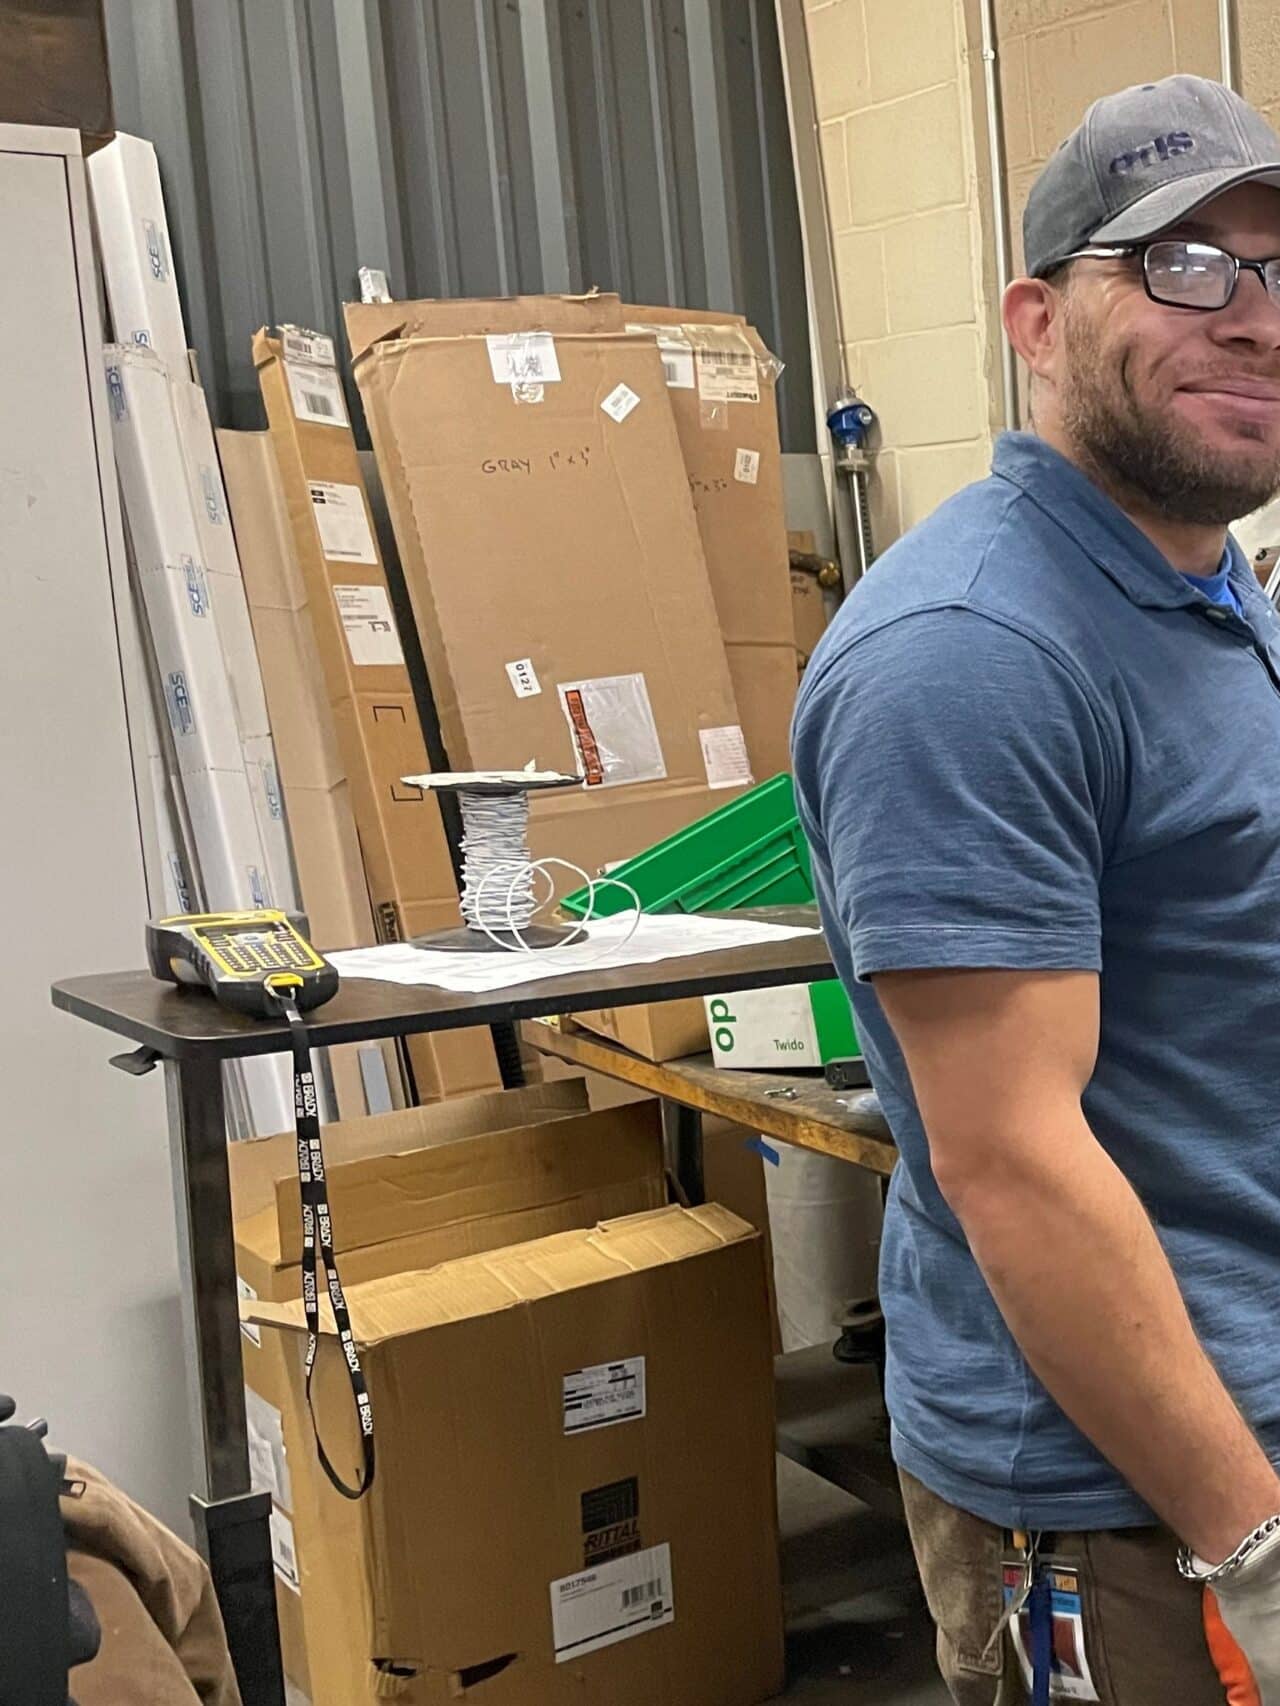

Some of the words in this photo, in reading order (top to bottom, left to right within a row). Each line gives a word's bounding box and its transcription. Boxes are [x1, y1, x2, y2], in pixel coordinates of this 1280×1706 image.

[481, 459, 531, 475] GRAY
[171, 673, 188, 709] SCE
[773, 1039, 804, 1051] Twido
[303, 1085, 317, 1117] BRADY
[298, 1139, 310, 1171] BRADY
[310, 1150, 325, 1182] BRADY
[302, 1204, 314, 1235] BRADY
[319, 1215, 332, 1248] BRADY
[304, 1271, 316, 1301] BRADY
[329, 1280, 346, 1311] BRADY
[343, 1340, 361, 1374] BRADY
[359, 1404, 373, 1437] BRADY
[585, 1520, 640, 1552] RITTAL
